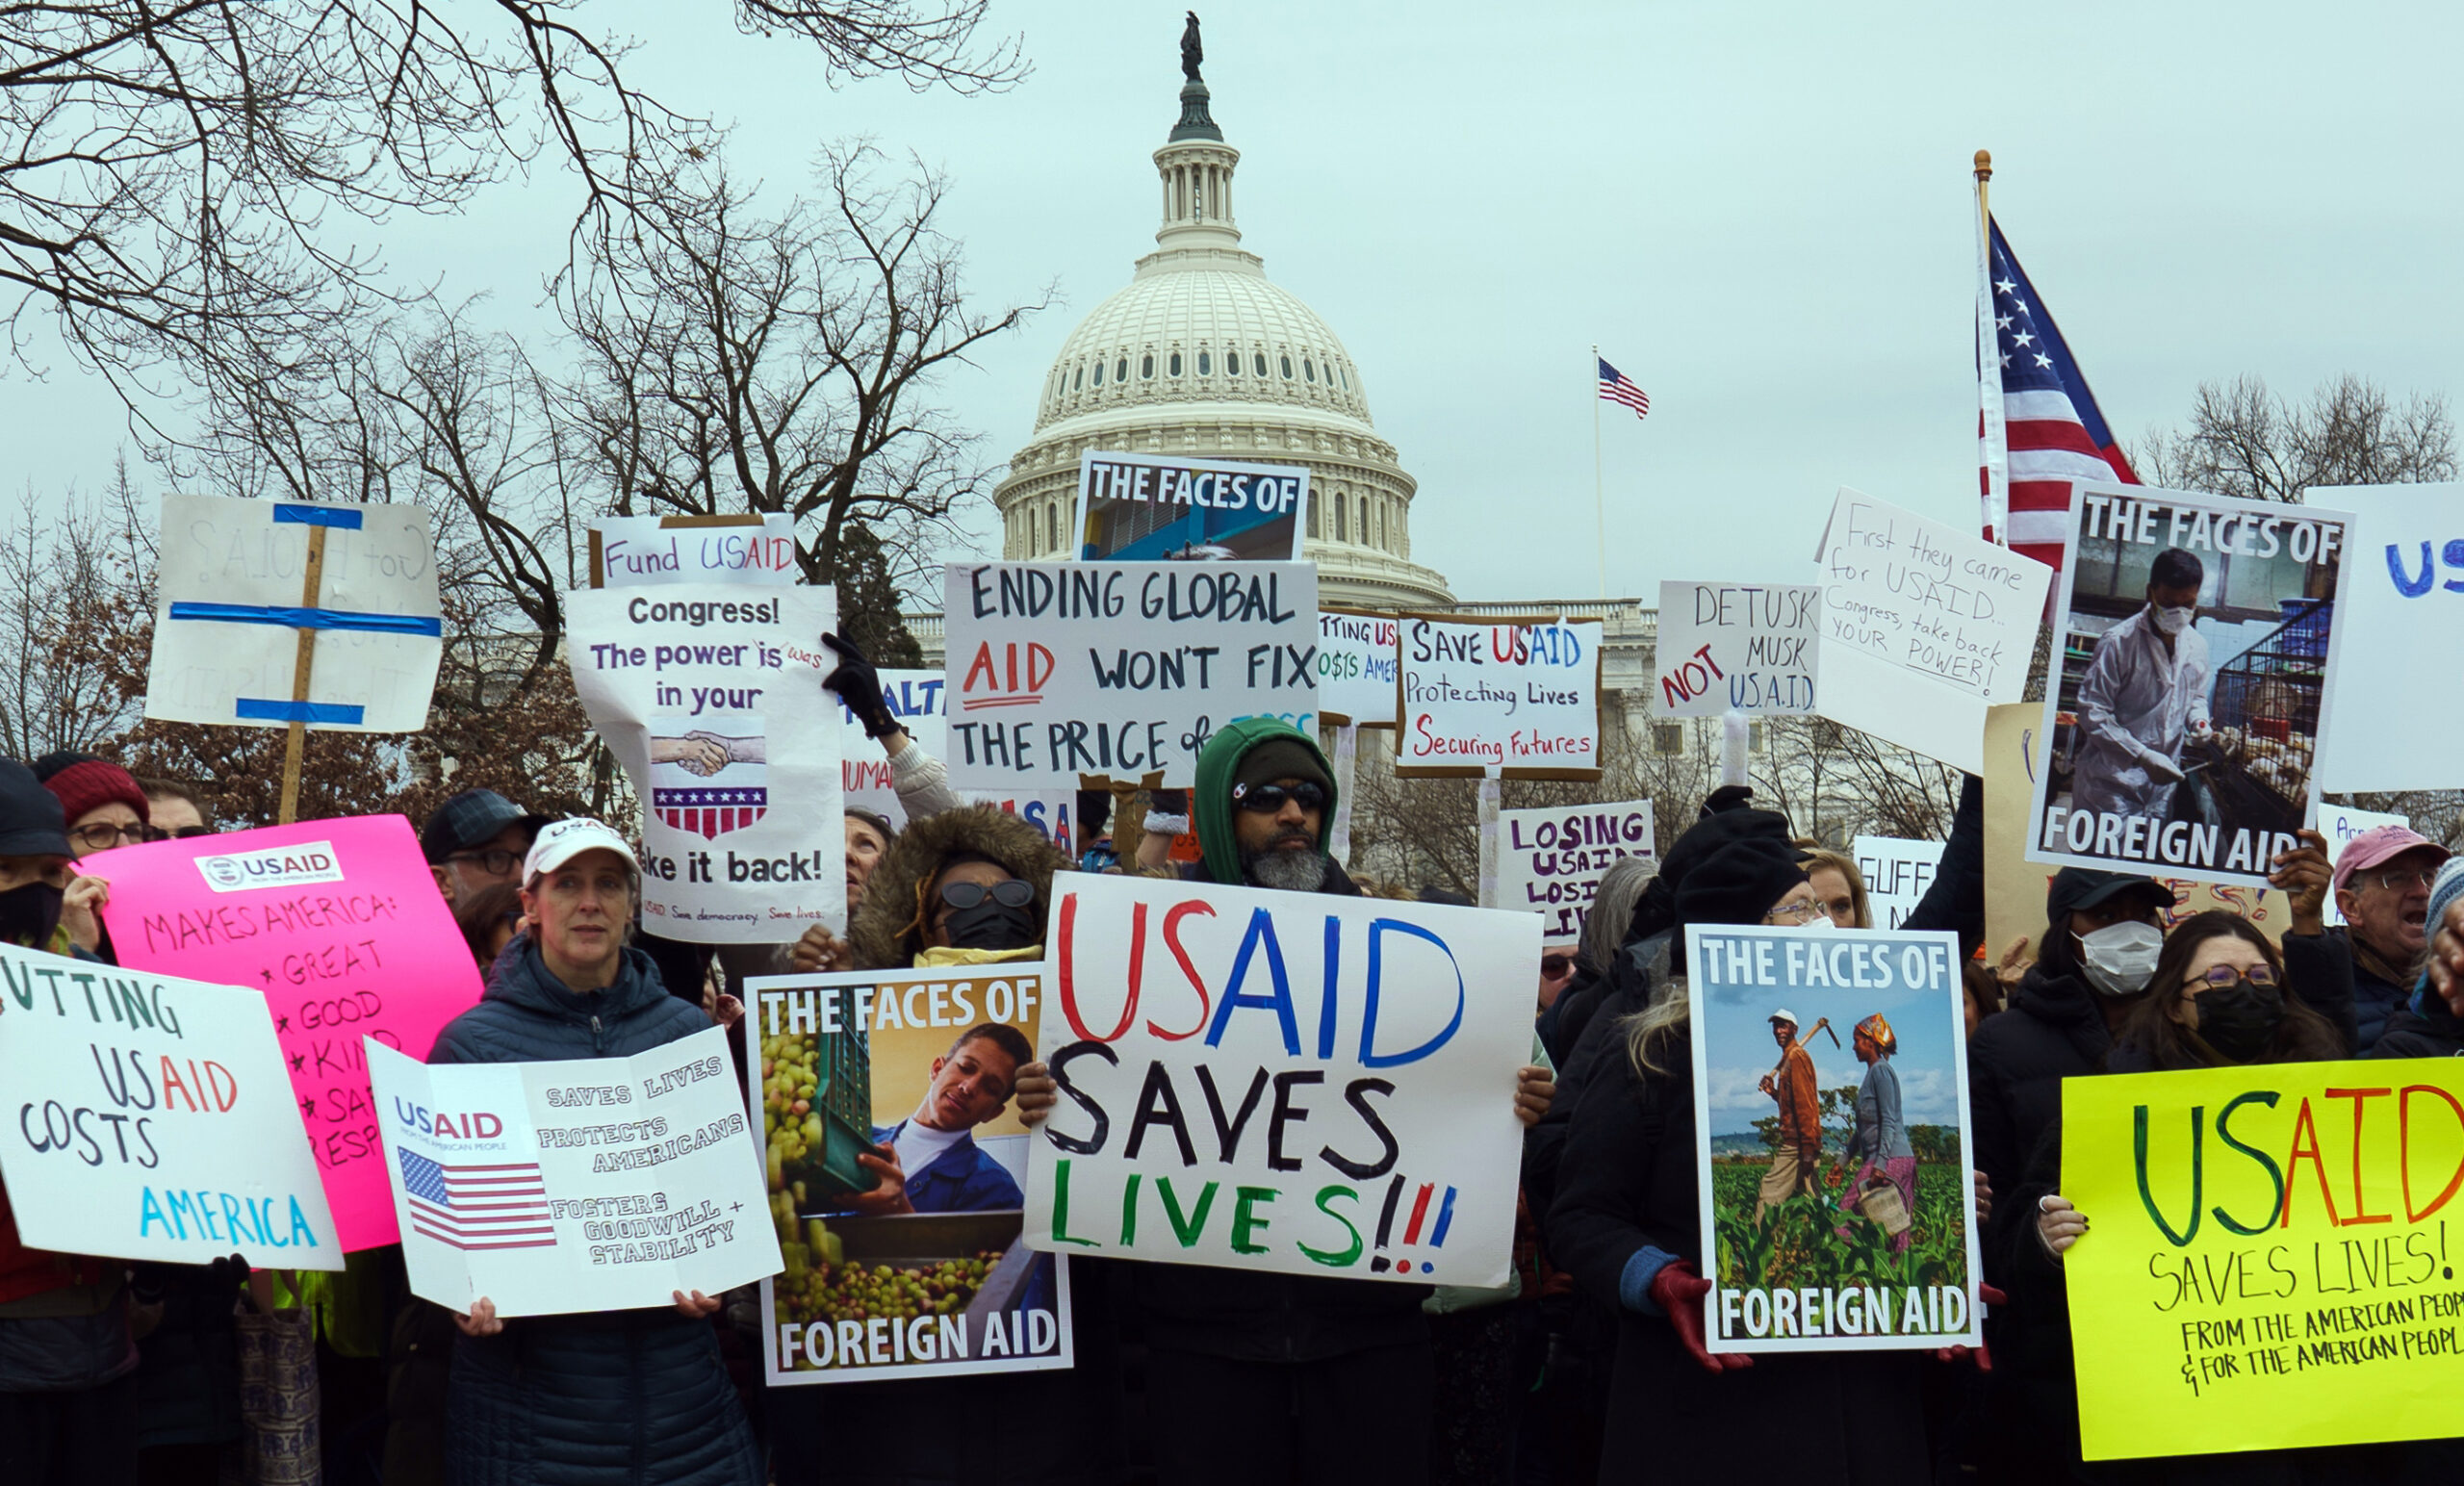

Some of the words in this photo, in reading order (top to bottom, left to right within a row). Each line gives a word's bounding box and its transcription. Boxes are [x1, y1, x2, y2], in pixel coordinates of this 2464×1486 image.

[1091, 463, 1149, 502] THE
[1158, 469, 1248, 510] FACES
[1256, 476, 1297, 514] OF
[604, 536, 680, 578] Fund
[701, 535, 793, 572] USAID
[1848, 502, 1895, 551] First
[1909, 527, 1953, 584] they
[1964, 558, 2022, 590] came
[2086, 497, 2160, 545] THE
[2169, 507, 2281, 558] FACES
[2290, 522, 2341, 566] OF
[1831, 547, 1870, 581] for
[629, 597, 780, 627] Congress!
[971, 565, 1125, 620] ENDING
[1141, 571, 1296, 626] GLOBAL
[1695, 585, 1818, 632] DETUSK
[1374, 622, 1396, 647] US
[1412, 620, 1484, 665] SAVE
[1492, 625, 1581, 668] USAID
[1826, 585, 1903, 630] Congress,
[1912, 613, 1950, 642] take
[1956, 627, 2003, 666] back
[590, 643, 647, 670] The
[655, 644, 749, 672] power
[787, 646, 823, 670] was
[962, 640, 1056, 694] AID
[1089, 645, 1220, 691] WON'T
[1246, 643, 1318, 691] FIX
[1661, 642, 1724, 708] NOT
[1746, 635, 1808, 672] MUSK
[1833, 616, 1887, 653] YOUR
[1909, 638, 1994, 696] POWER!
[656, 681, 682, 706] in
[690, 686, 763, 716] your
[1406, 671, 1517, 716] Protecting
[1527, 681, 1579, 705] Lives
[951, 722, 1035, 772] THE
[1048, 720, 1168, 772] PRICE
[1181, 715, 1213, 763] of
[1413, 713, 1503, 765] Securing
[1510, 729, 1591, 759] Futures
[1511, 812, 1644, 851] LOSING
[2043, 805, 2219, 866] FOREIGN
[2225, 825, 2298, 874] AID
[243, 854, 330, 876] USAID
[688, 851, 712, 883] it
[728, 850, 821, 883] back!
[143, 906, 257, 954] MAKES
[264, 894, 397, 934] AMERICA:
[283, 939, 381, 985] GREAT
[1058, 891, 1465, 1068] USAID
[1701, 937, 1777, 986] THE
[1785, 941, 1893, 989] FACES
[1901, 944, 1947, 990] OF
[300, 990, 382, 1030] GOOD
[760, 989, 842, 1037] THE
[854, 981, 976, 1032] FACES
[985, 978, 1037, 1024] OF
[90, 1042, 238, 1114] USAID
[546, 1084, 631, 1108] SAVES
[643, 1056, 724, 1099] LIVES
[20, 1099, 159, 1169] COSTS
[395, 1095, 503, 1140] USAID
[537, 1116, 668, 1148] PROTECTS
[1043, 1038, 1399, 1181] SAVES
[593, 1113, 744, 1173] AMERICANS
[2133, 1084, 2464, 1247] USAID
[141, 1185, 320, 1248] AMERICA
[551, 1191, 669, 1219] FOSTERS
[583, 1199, 722, 1241] GOODWILL
[588, 1219, 734, 1265] STABILITY
[2148, 1244, 2297, 1312] SAVES
[2314, 1219, 2454, 1294] LIVES!
[1721, 1286, 1890, 1338] FOREIGN
[1901, 1286, 1968, 1334] AID
[2181, 1318, 2246, 1352] FROM
[2250, 1313, 2298, 1343] THE
[2305, 1297, 2415, 1339] AMERICAN
[780, 1311, 969, 1371] FOREIGN
[982, 1308, 1057, 1358] AID
[2200, 1353, 2241, 1385] FOR
[2245, 1345, 2292, 1375] THE
[2297, 1334, 2399, 1371] AMERICAN
